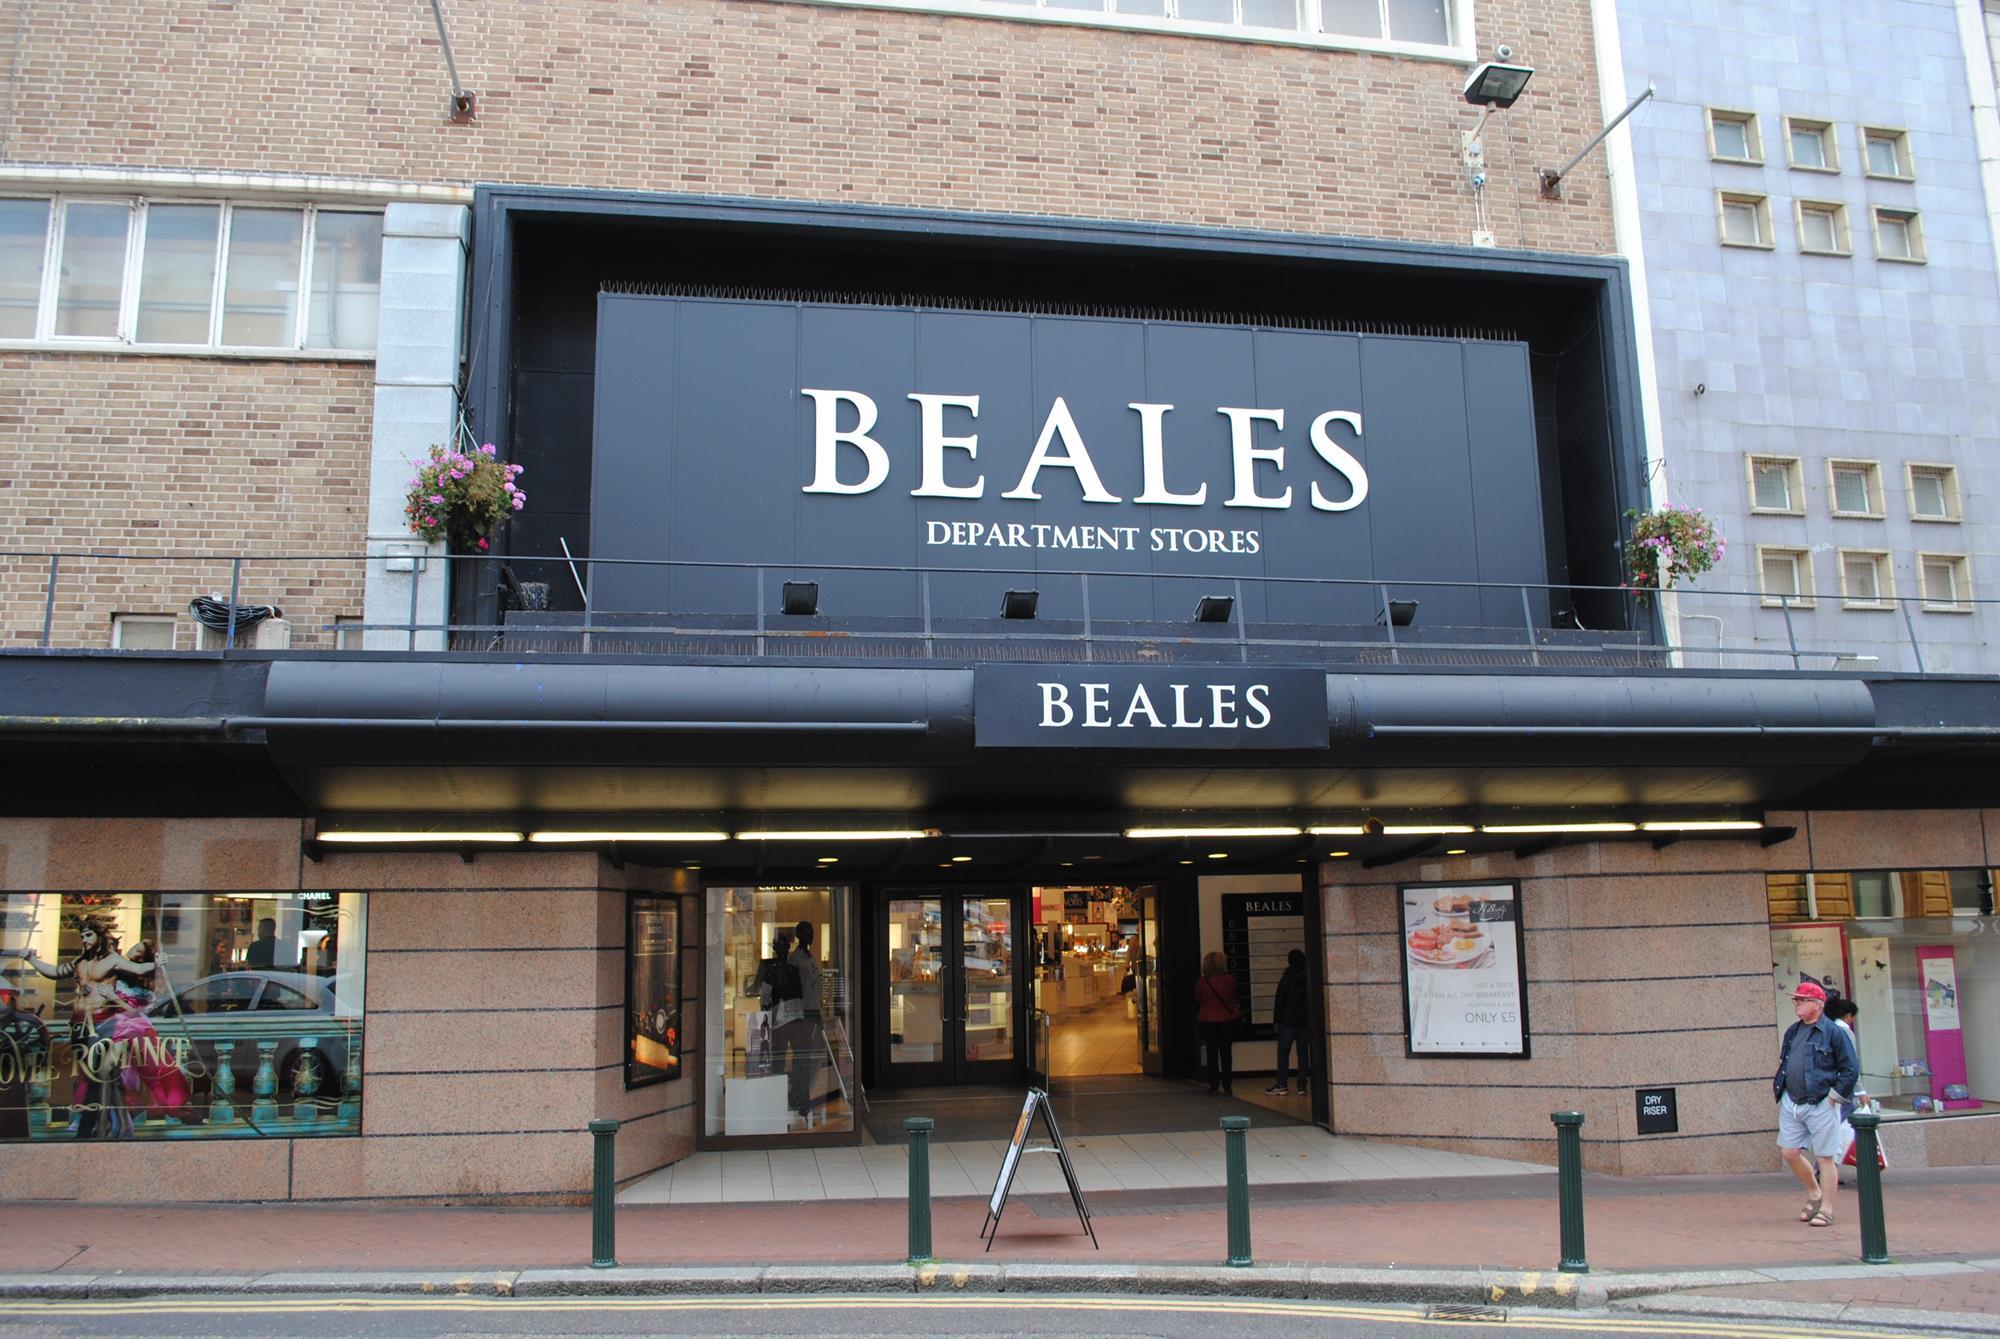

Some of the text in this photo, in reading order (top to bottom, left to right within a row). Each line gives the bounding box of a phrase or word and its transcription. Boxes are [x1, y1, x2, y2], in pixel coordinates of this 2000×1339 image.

[801, 388, 1369, 511] BEALES
[926, 520, 1260, 554] DEPARTMENT STORES
[1037, 682, 1271, 729] BEALES
[298, 892, 332, 900] CHANEL
[1245, 901, 1292, 912] BEALES
[1475, 991, 1514, 999] BREAKFAST
[1464, 1011, 1516, 1024] ONLY £5
[62, 1036, 192, 1083] ROMANCE
[1645, 1095, 1662, 1105] DRY
[1643, 1105, 1667, 1116] RISER
